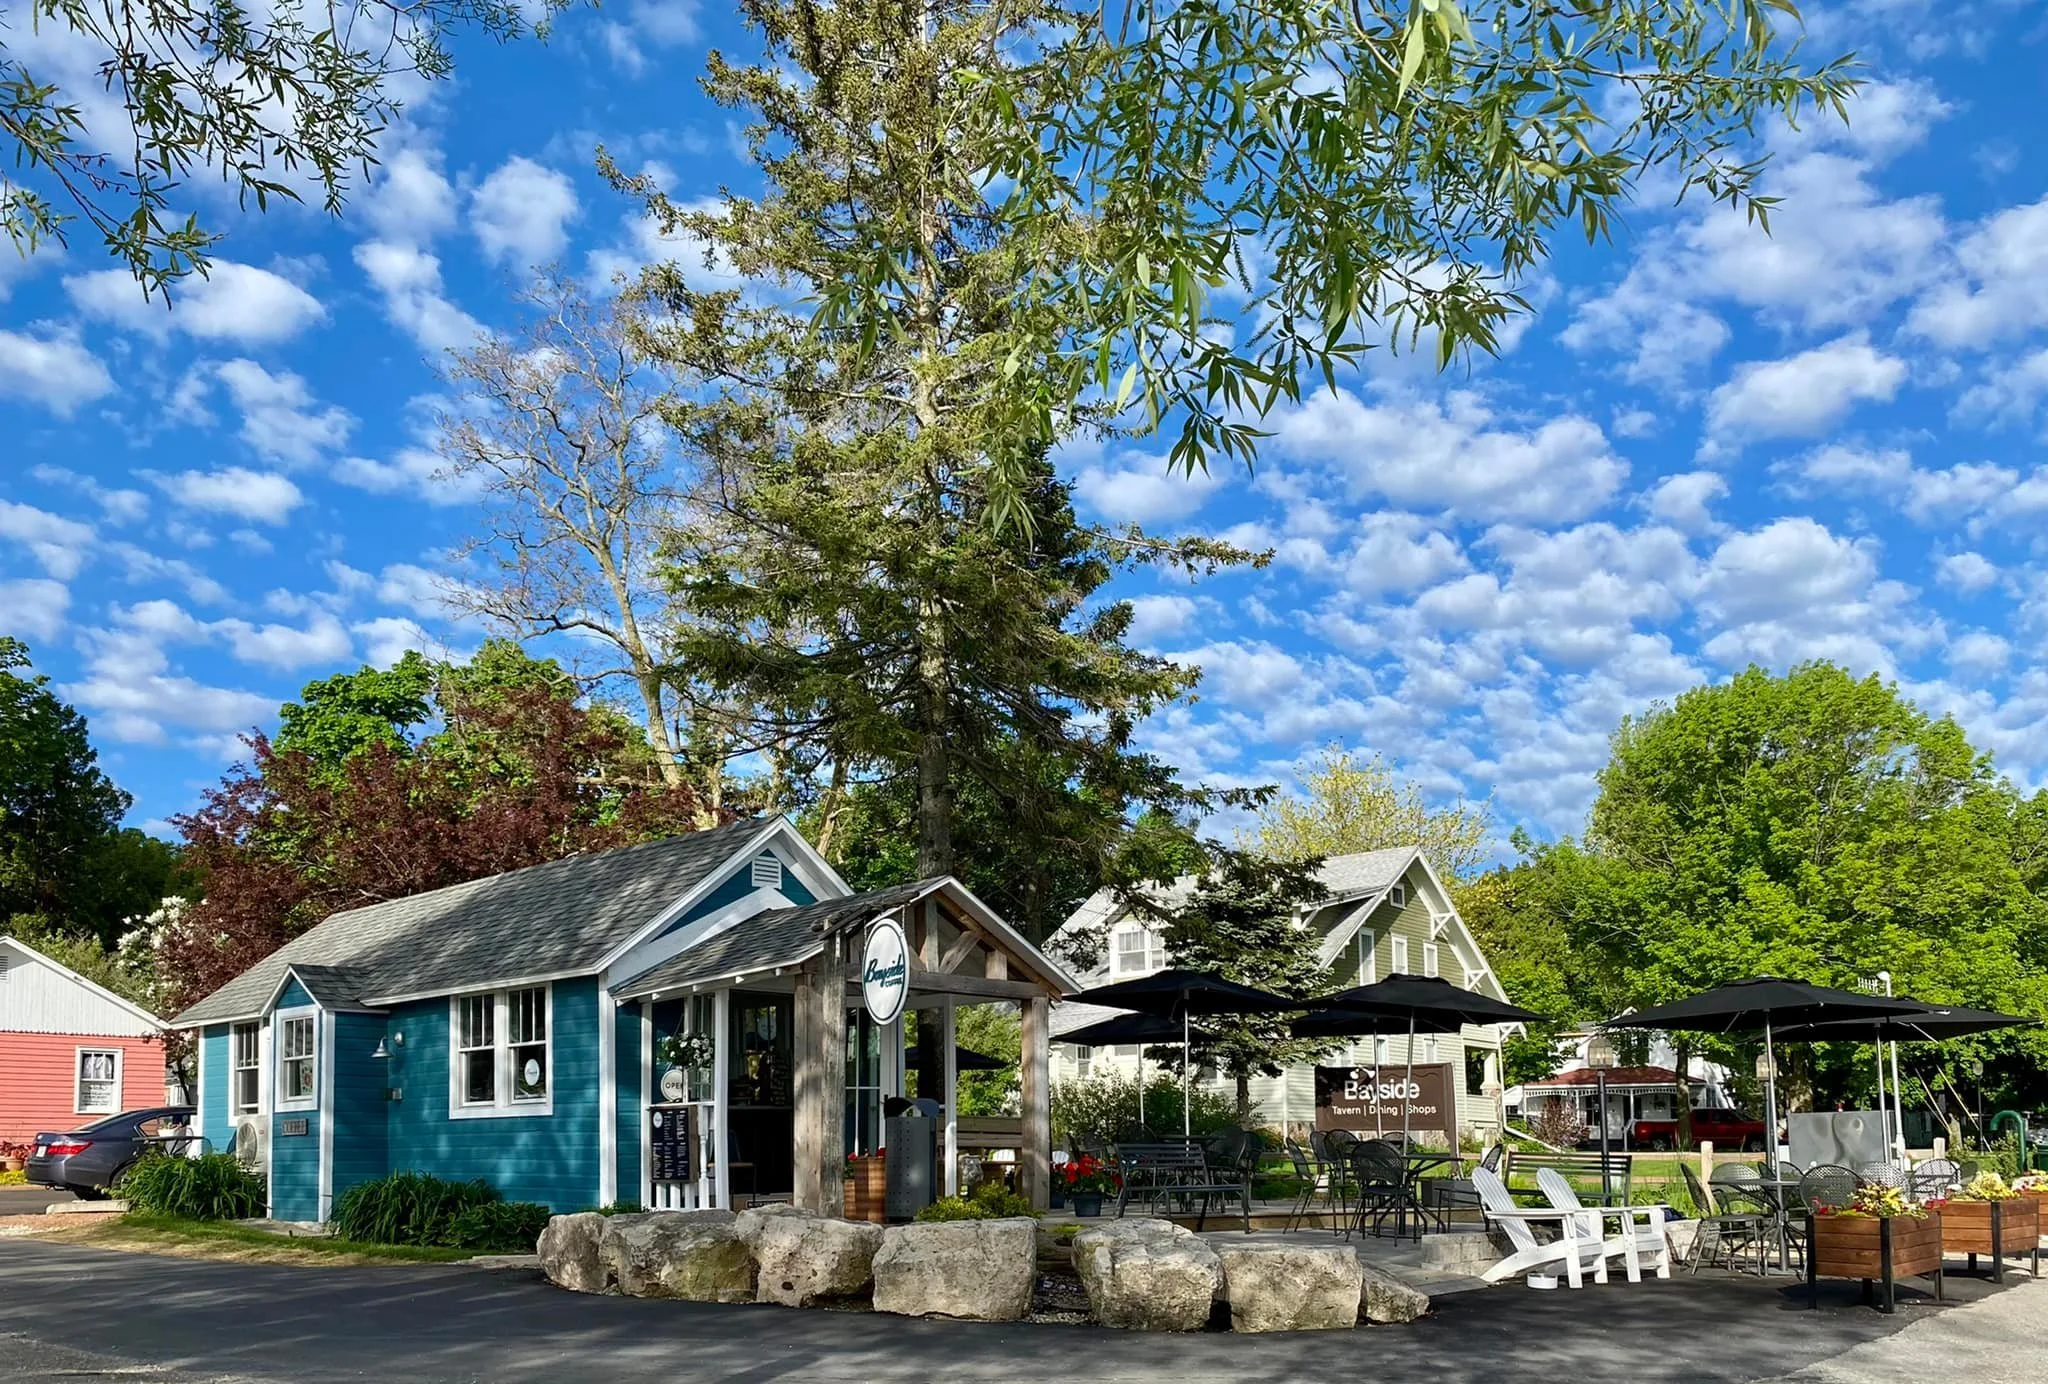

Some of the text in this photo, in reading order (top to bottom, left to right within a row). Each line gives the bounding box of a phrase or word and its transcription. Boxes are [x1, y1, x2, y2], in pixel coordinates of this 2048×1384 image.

[864, 953, 905, 988] Bayside
[665, 1082, 682, 1090] OPE
[1344, 1078, 1420, 1104] Bayside
[1332, 1105, 1361, 1115] Tavern
[1369, 1104, 1398, 1116] Dning
